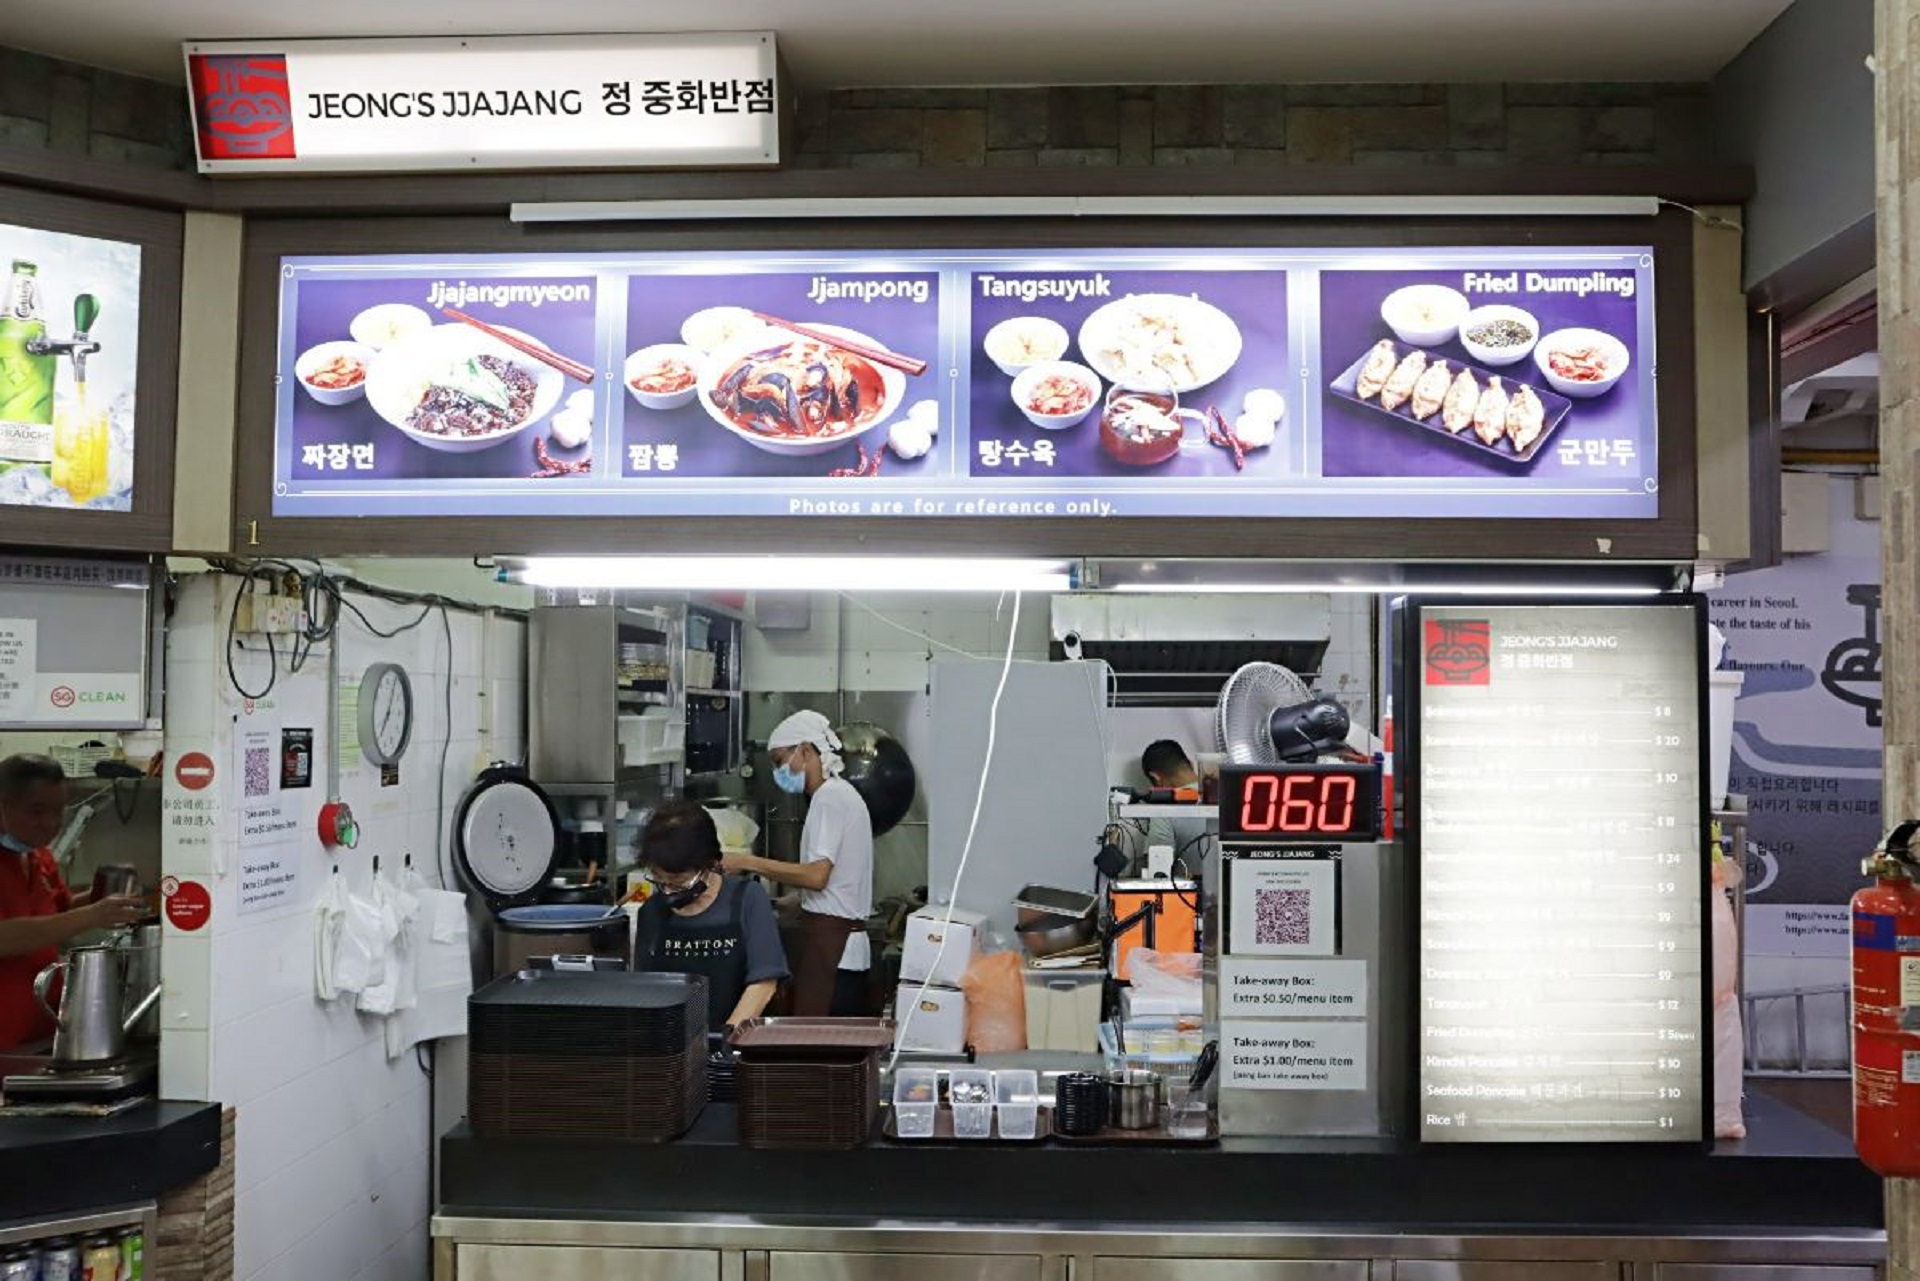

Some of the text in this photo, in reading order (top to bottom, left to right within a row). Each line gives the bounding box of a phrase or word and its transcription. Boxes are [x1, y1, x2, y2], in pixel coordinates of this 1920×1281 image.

[309, 90, 584, 119] JEONG'S JJAJANG
[602, 78, 776, 116] 정 중화반점
[427, 281, 591, 308] Jjajangmyeon
[807, 276, 930, 303] Jjampong
[978, 275, 1111, 301] Tangsuyuk
[1463, 272, 1635, 298] Fried Dumpling
[302, 443, 375, 470] 짜장면
[629, 443, 680, 470] 짬뽕
[978, 439, 1056, 466] 탕수육
[1557, 439, 1636, 466] 군만두
[789, 497, 1118, 517] Photos are for reference only.
[1711, 597, 1798, 609] career in Seoul.
[1729, 618, 1747, 628] the
[1750, 619, 1778, 630] taste
[1780, 618, 1792, 630] of
[1794, 619, 1811, 630] his
[1501, 635, 1619, 648] JEONG'S JJAJANG
[78, 691, 126, 702] CLEAN
[1241, 775, 1356, 832] 060
[1233, 976, 1315, 988] Take-away Box:
[1233, 993, 1353, 1005] Extra $0.50/menu item
[1233, 1037, 1316, 1049] Take-away Box:
[1233, 1056, 1353, 1067] Extra $1.00/menu item
[1427, 1114, 1451, 1125] Rice
